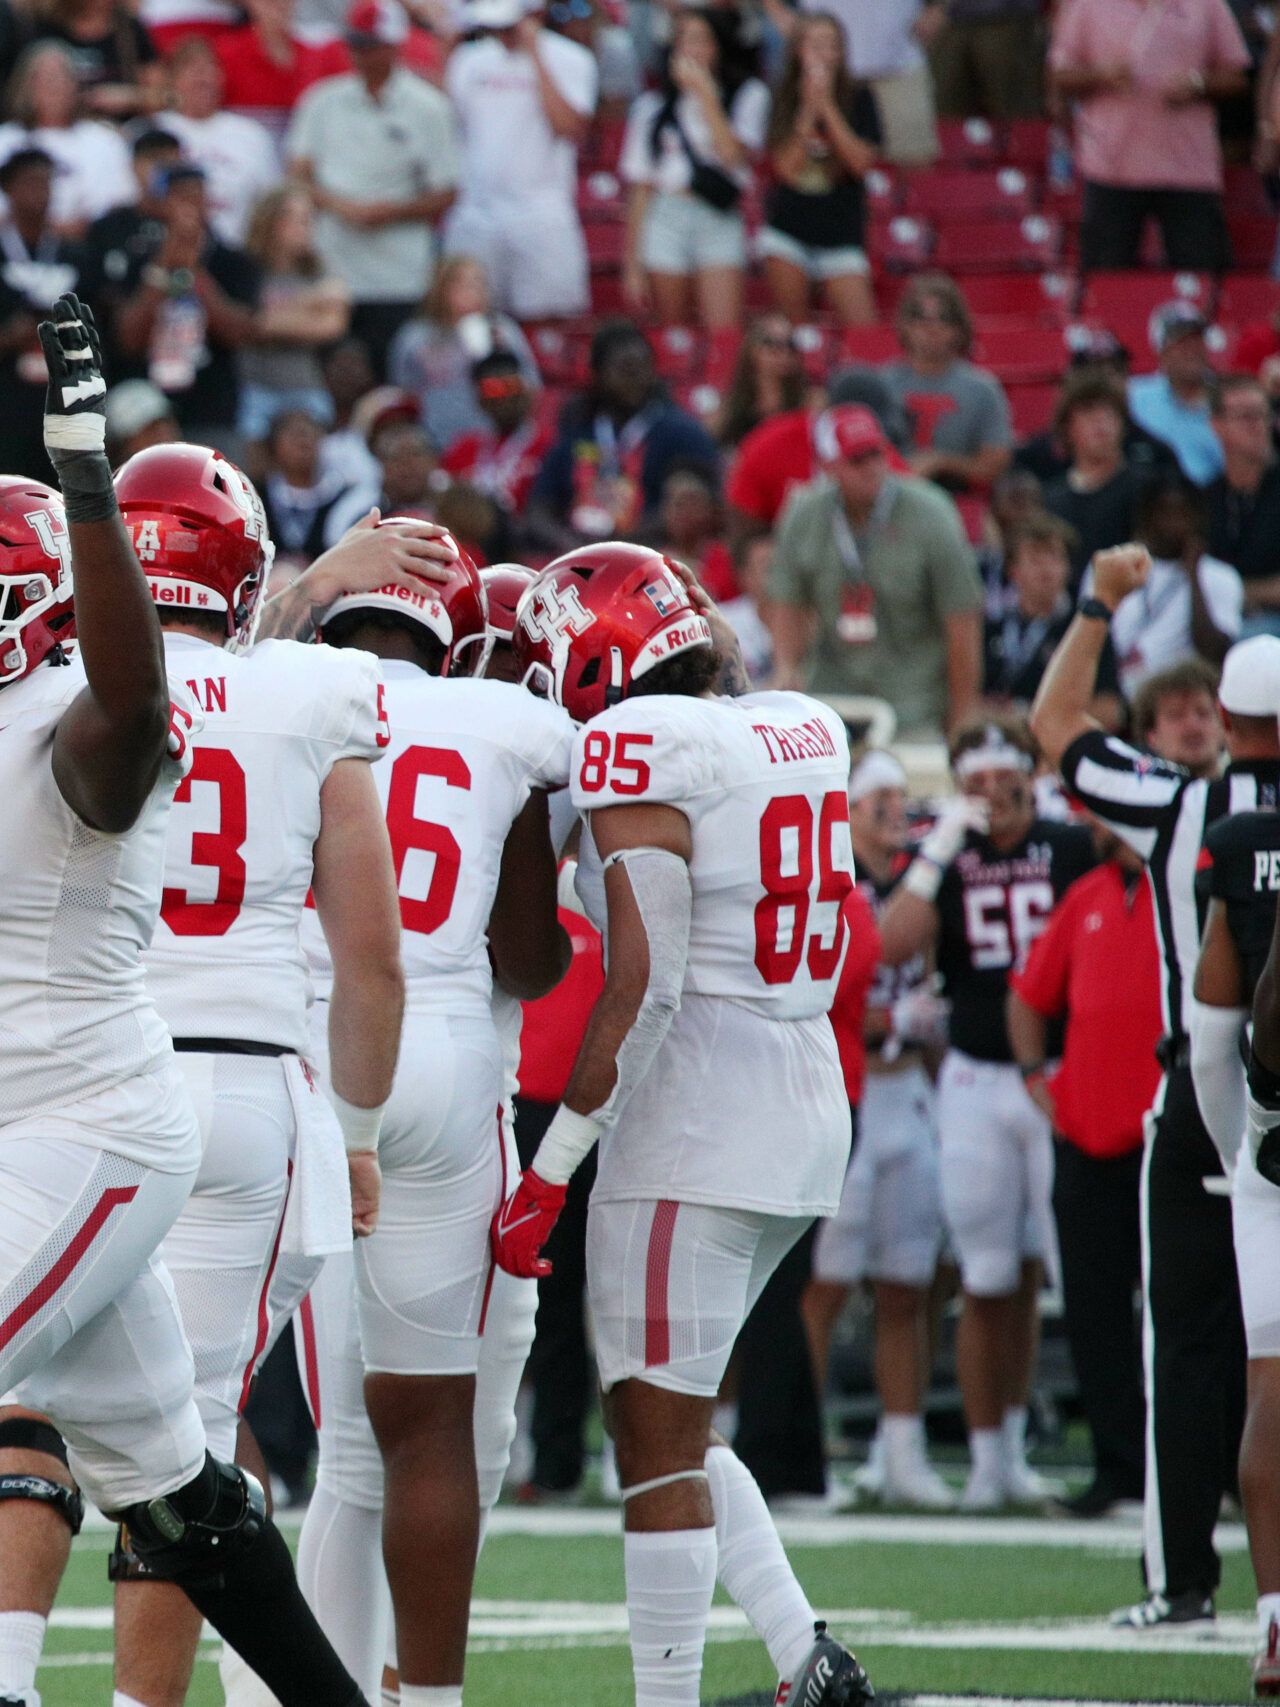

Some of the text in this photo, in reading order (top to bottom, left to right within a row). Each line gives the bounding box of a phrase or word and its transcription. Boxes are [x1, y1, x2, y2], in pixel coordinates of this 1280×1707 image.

[150, 582, 192, 605] dell
[580, 730, 654, 796] 85
[754, 791, 854, 985] 85
